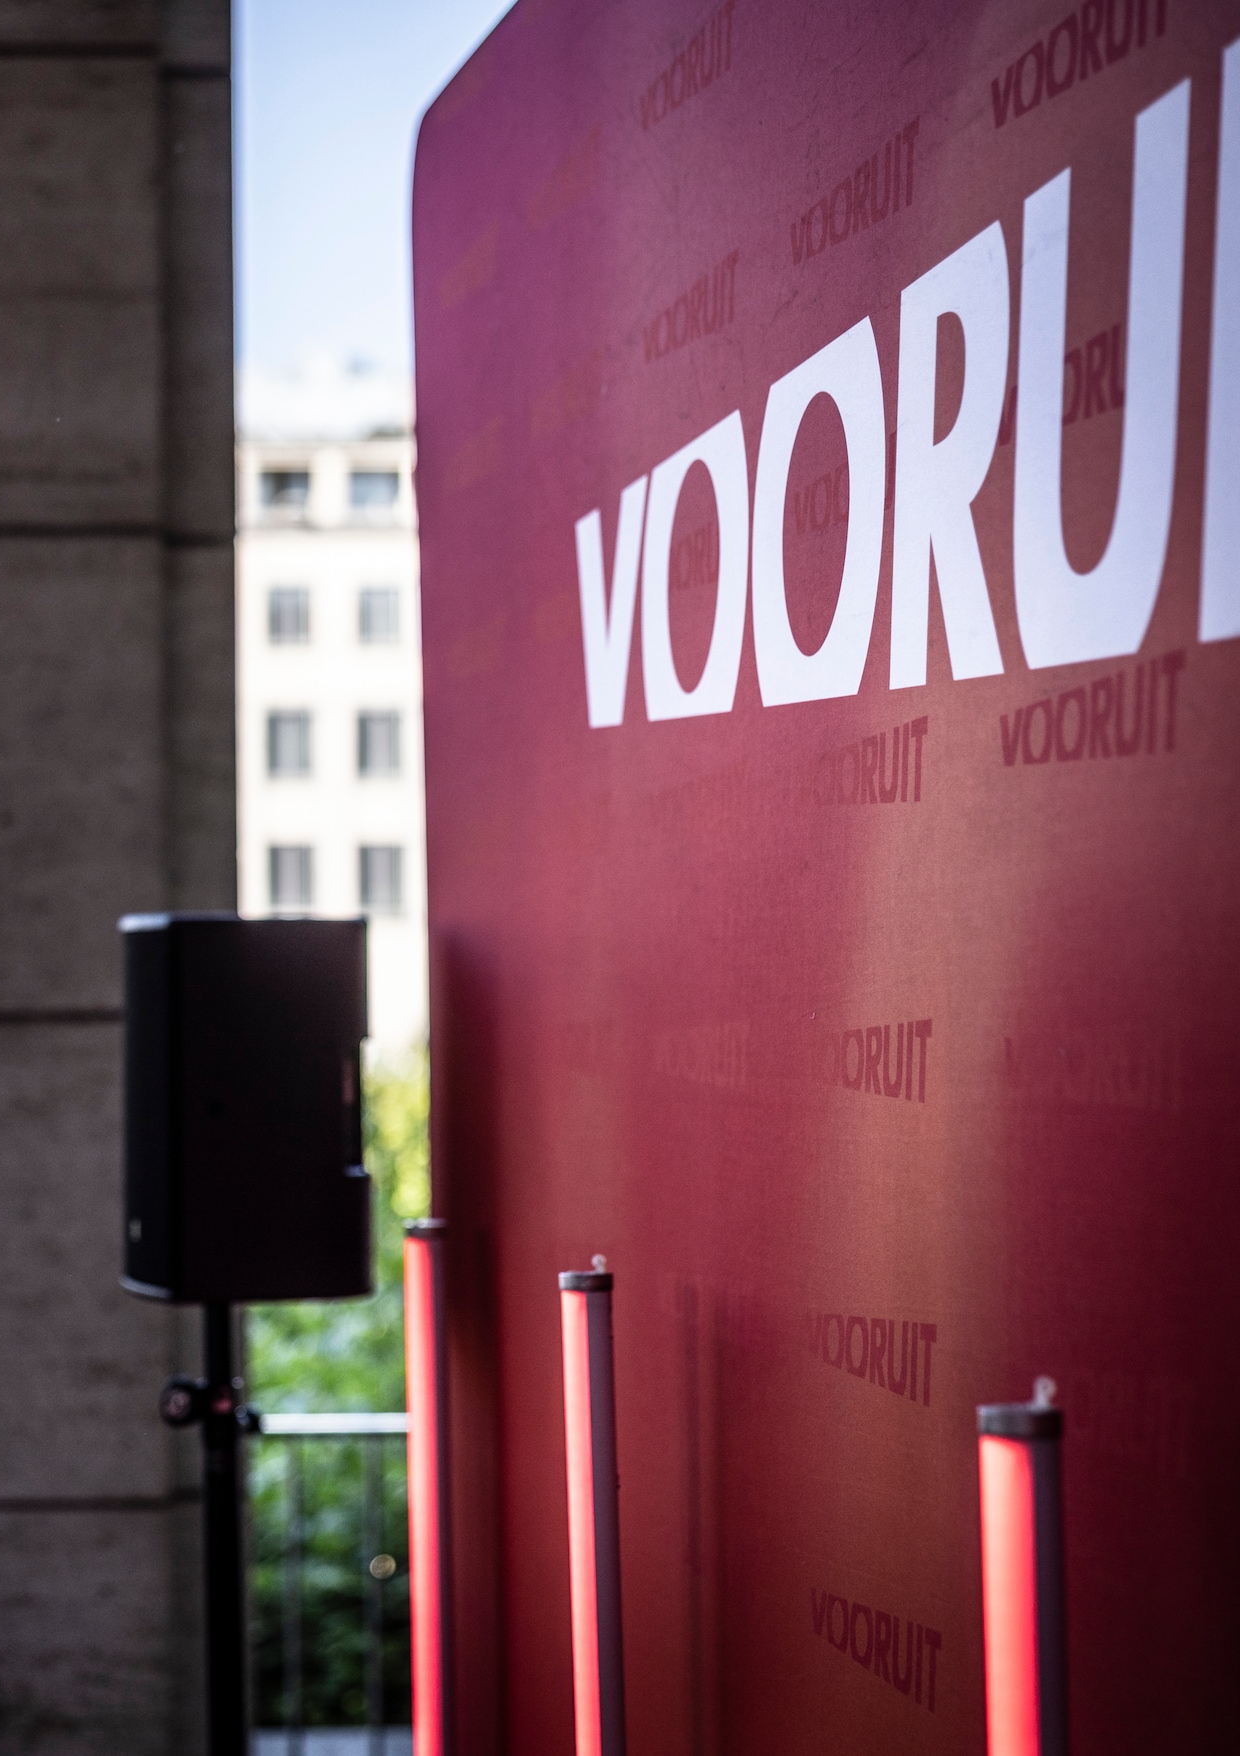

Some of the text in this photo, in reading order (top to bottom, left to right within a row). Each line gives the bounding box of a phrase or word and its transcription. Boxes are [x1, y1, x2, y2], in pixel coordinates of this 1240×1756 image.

[790, 115, 920, 266] VOORUIT
[643, 248, 739, 363] VOORUIT
[999, 648, 1187, 767] VOORUIT
[811, 1587, 943, 1714] VOORUIT
